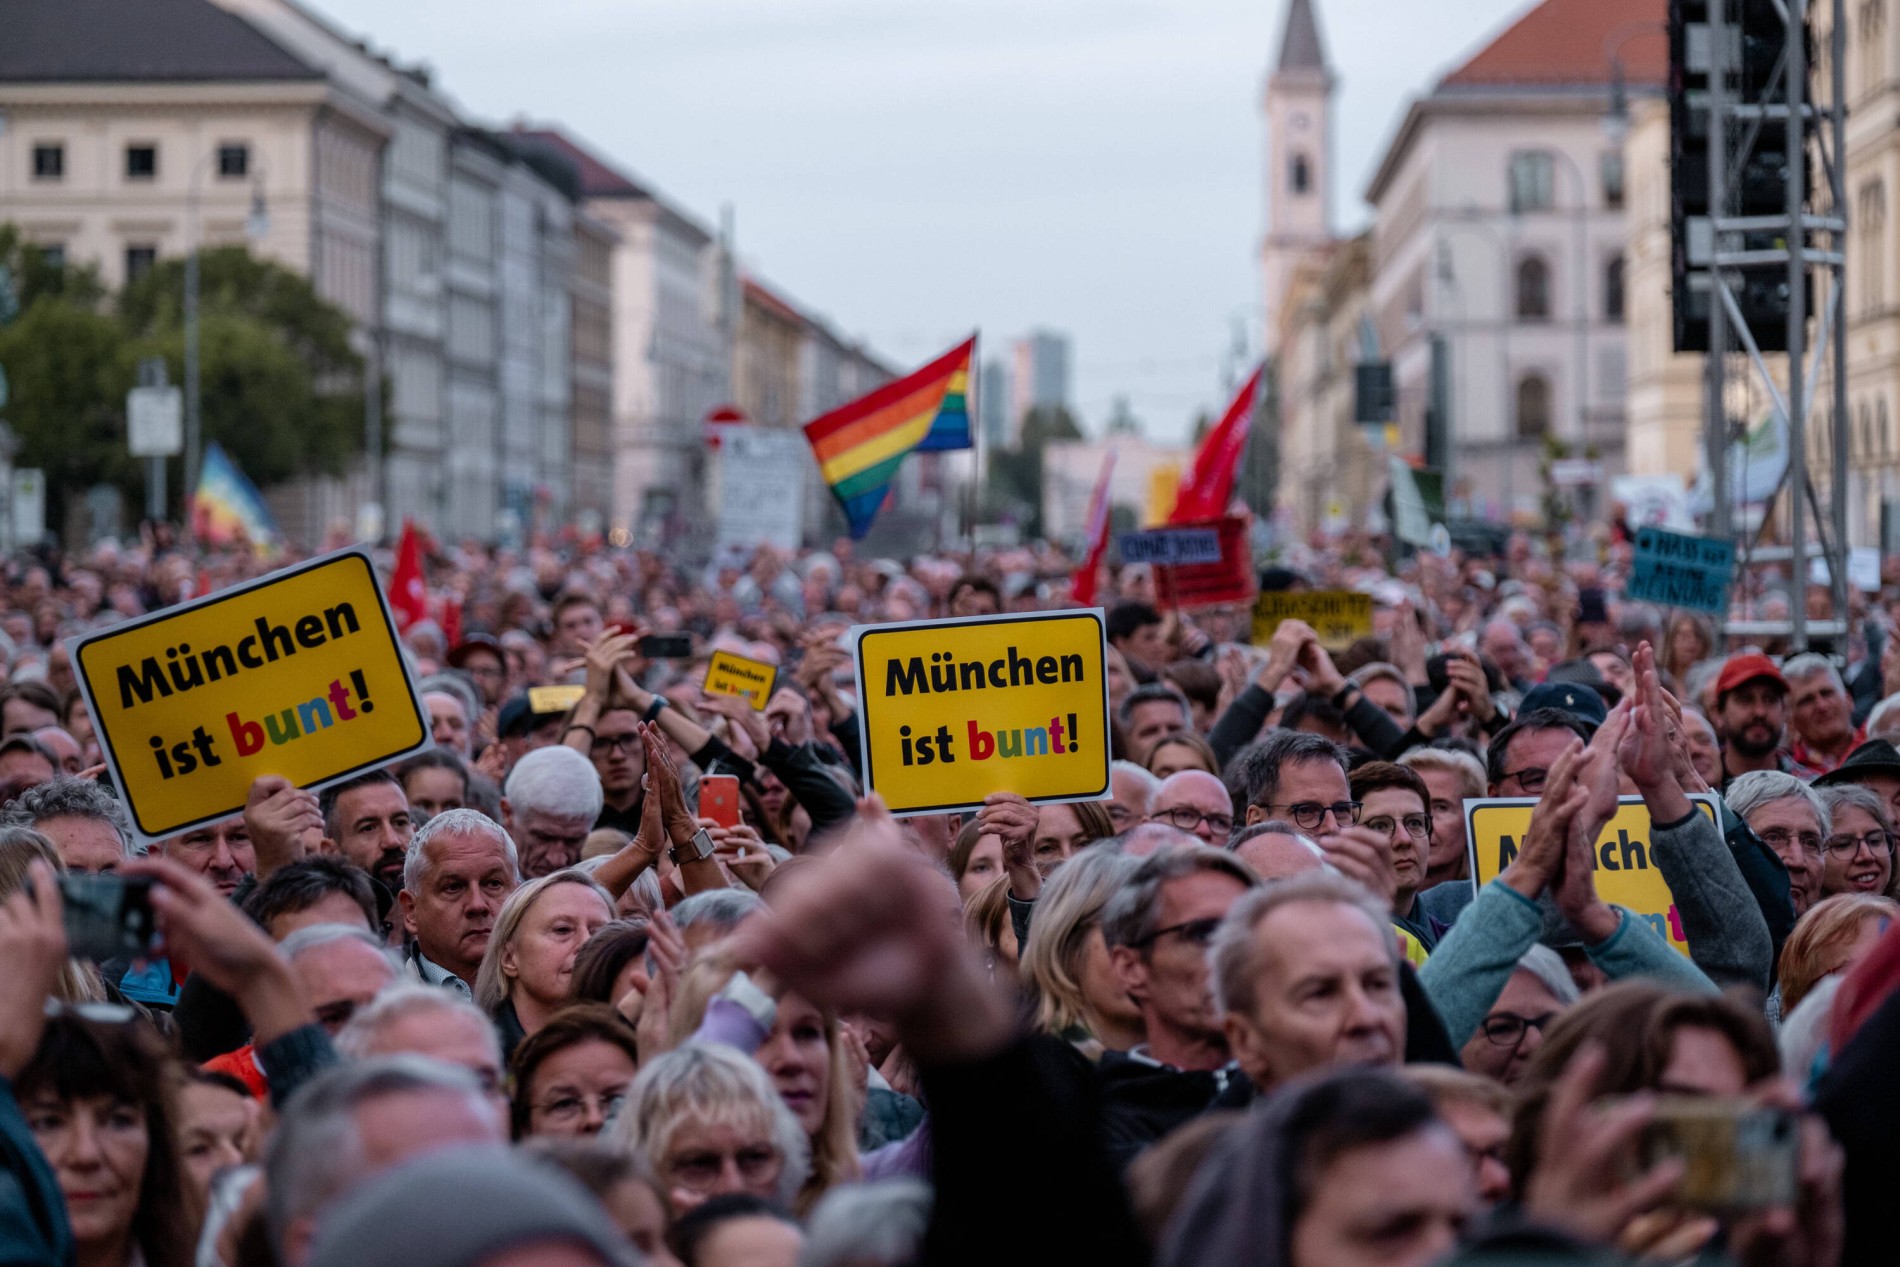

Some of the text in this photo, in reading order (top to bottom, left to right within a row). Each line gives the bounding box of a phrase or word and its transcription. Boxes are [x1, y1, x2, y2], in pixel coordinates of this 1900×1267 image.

[116, 602, 360, 709] München
[717, 662, 766, 684] München
[885, 646, 1084, 696] München
[714, 679, 728, 692] ist
[149, 669, 374, 780] ist bunt!
[899, 713, 1079, 766] ist bunt!
